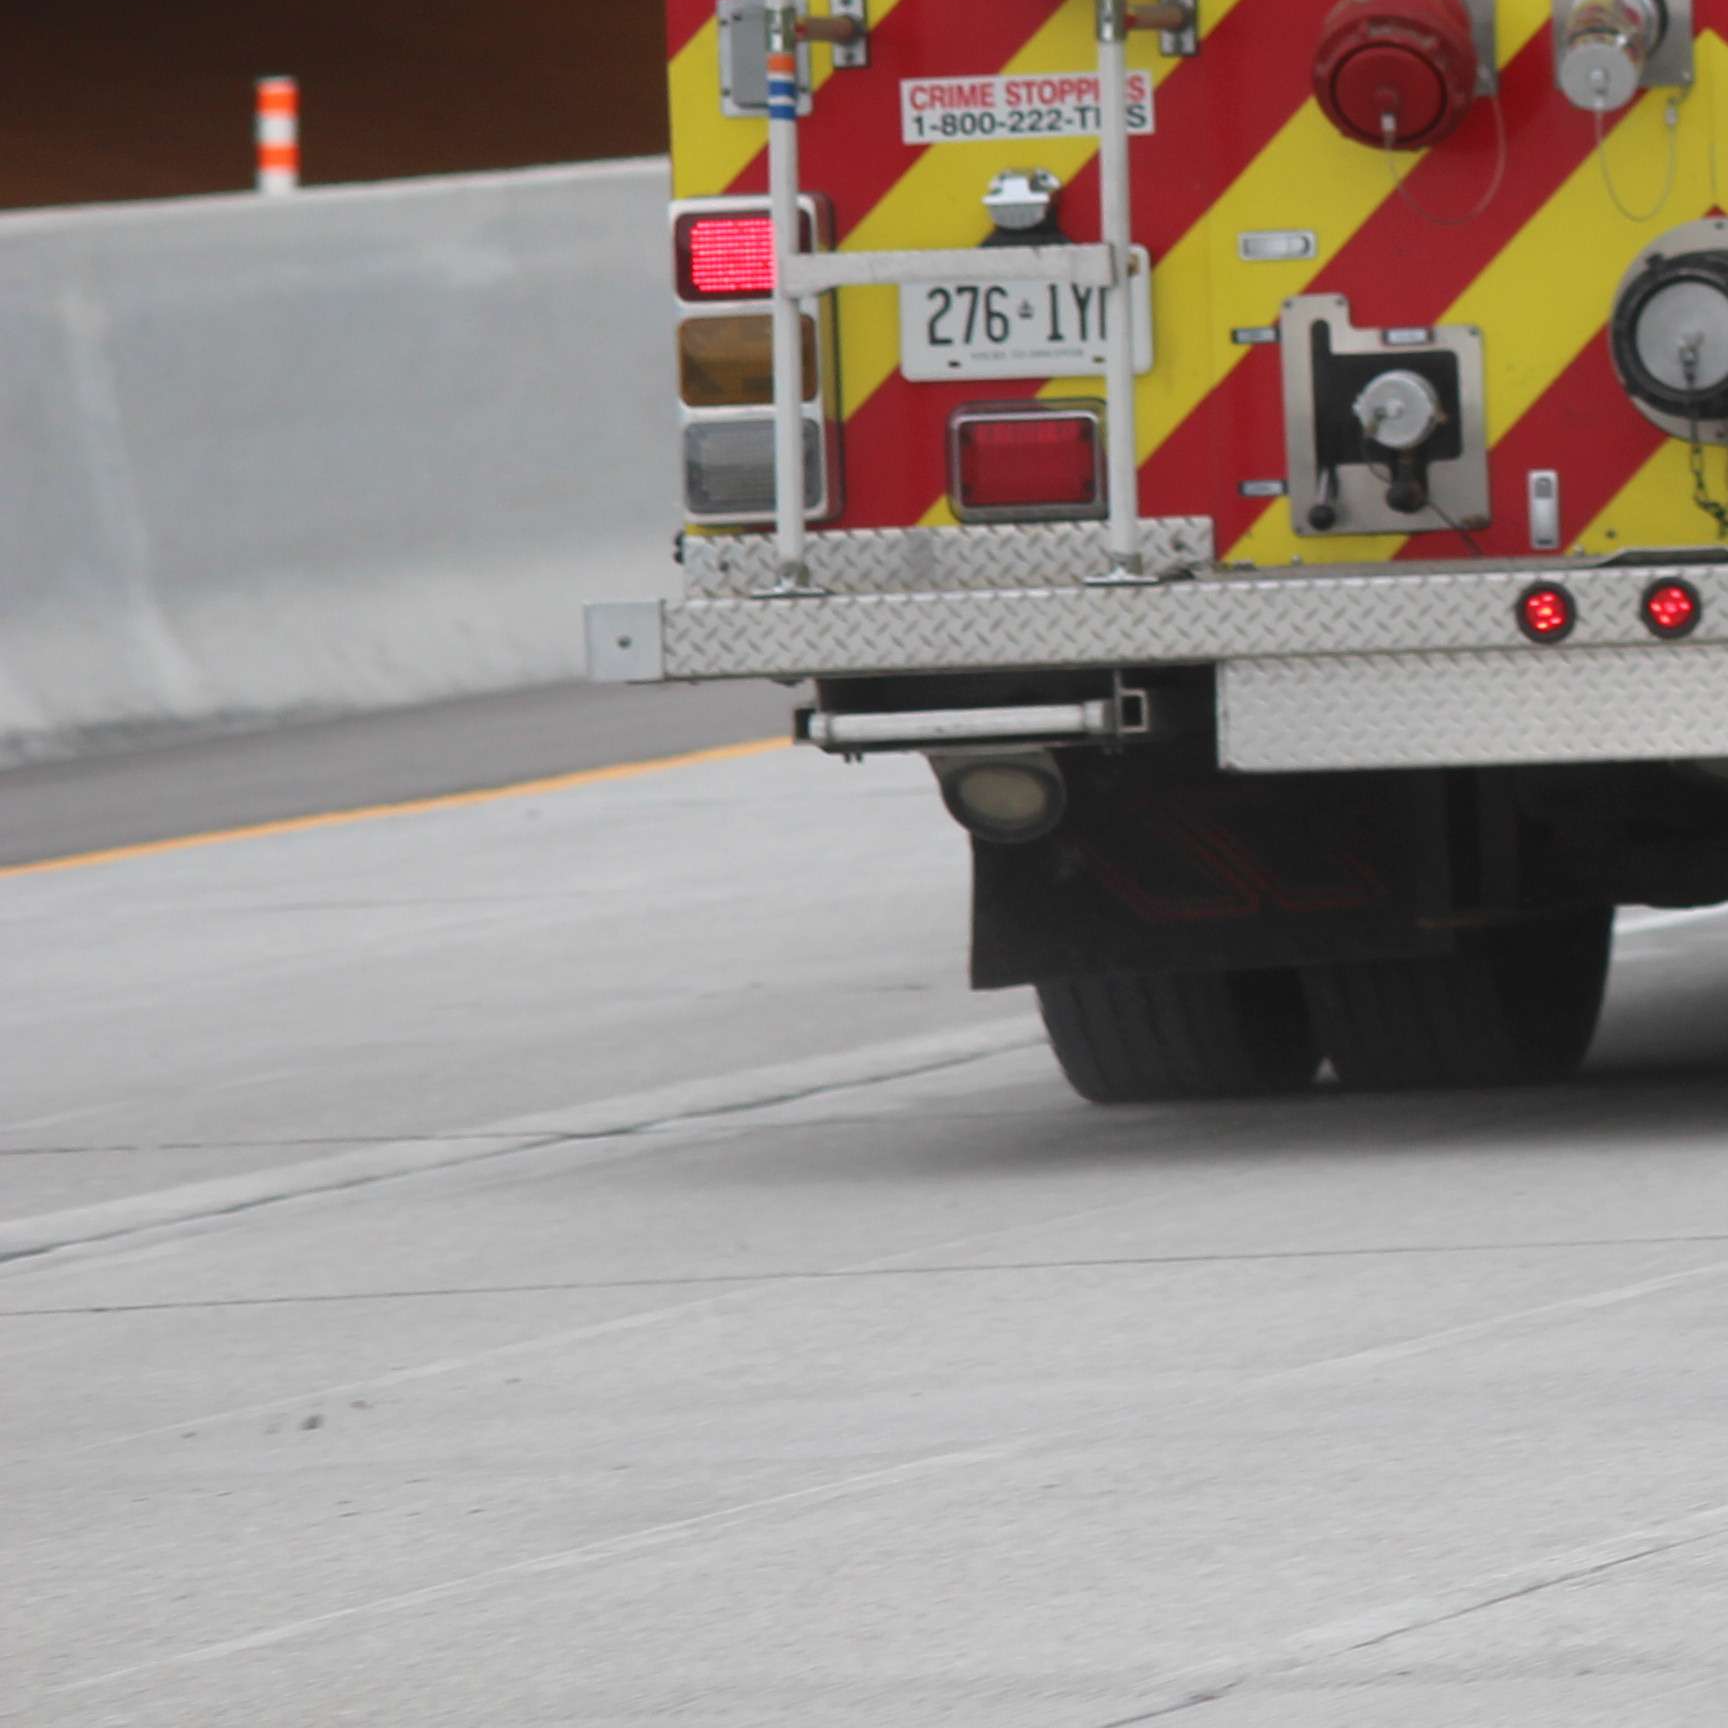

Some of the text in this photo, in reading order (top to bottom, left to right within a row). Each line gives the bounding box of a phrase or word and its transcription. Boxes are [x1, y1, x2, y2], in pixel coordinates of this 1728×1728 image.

[909, 74, 1146, 111] CRIME STOPPS
[913, 104, 1147, 138] 1-800-222-TIS
[926, 285, 1010, 346] 276
